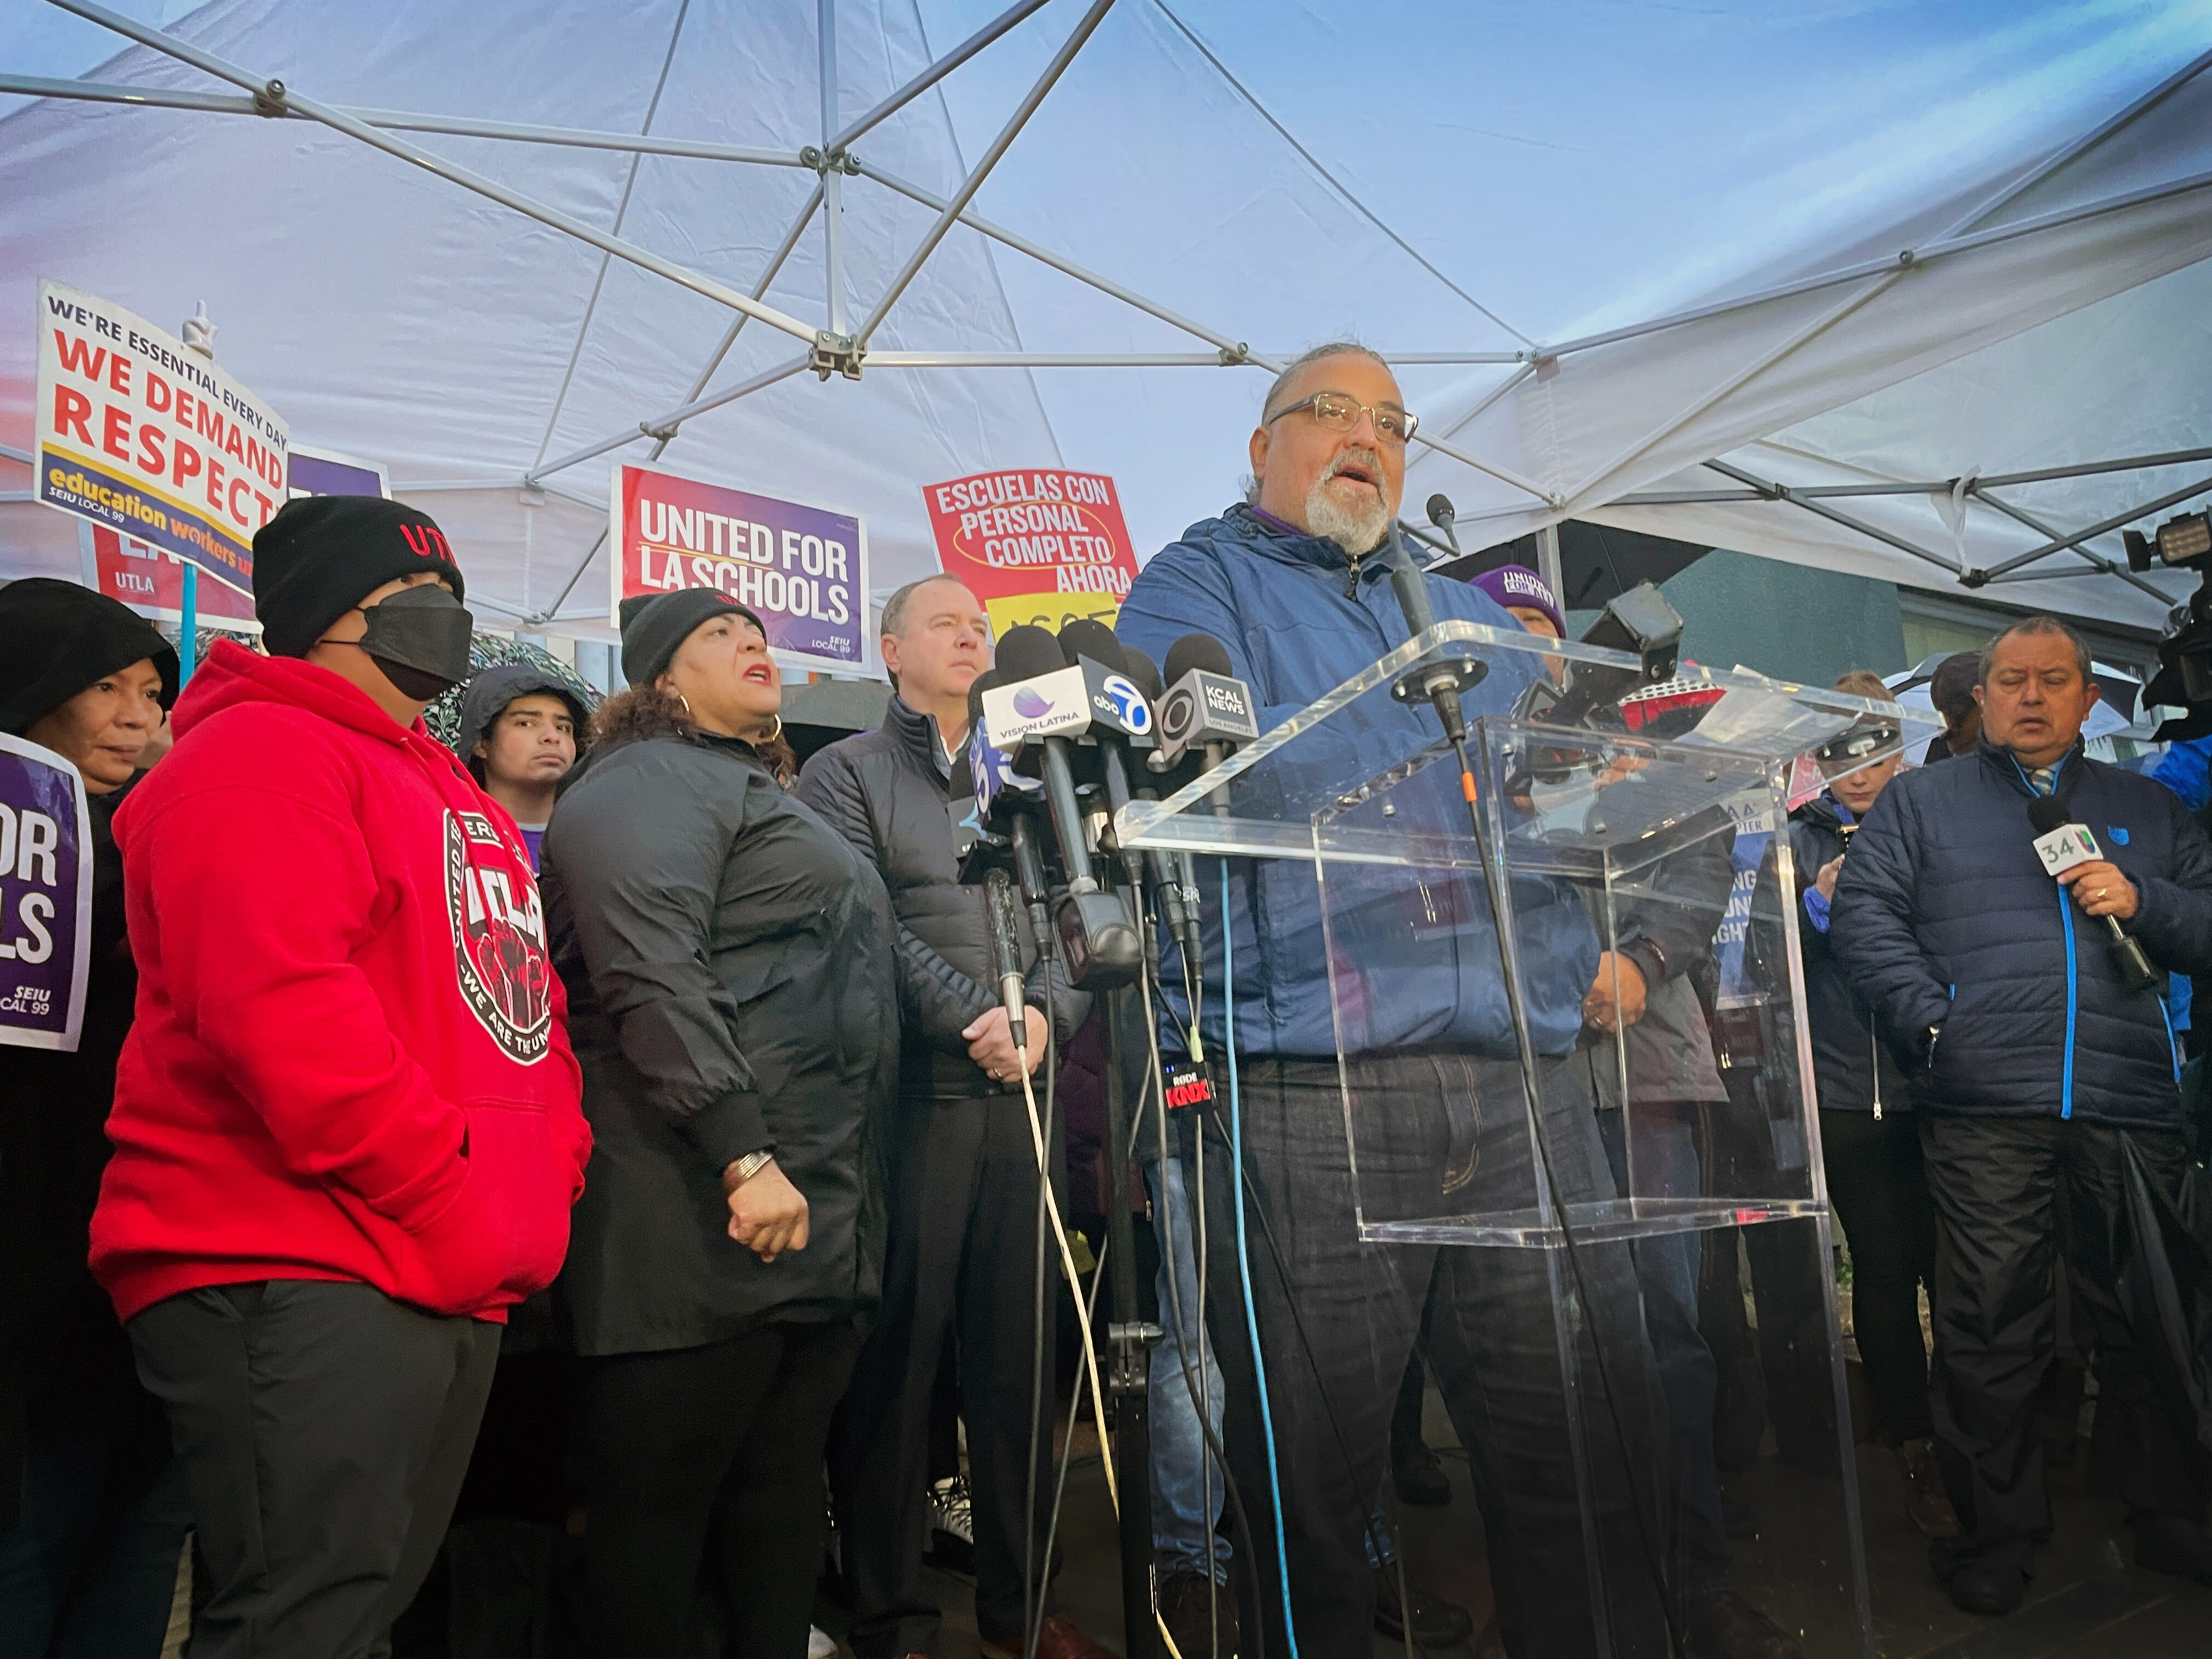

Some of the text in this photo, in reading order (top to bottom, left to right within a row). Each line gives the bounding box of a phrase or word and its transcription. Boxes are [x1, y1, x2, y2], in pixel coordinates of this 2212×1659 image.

[48, 296, 287, 452] WE'RE ESSENTIAL EVERY DAY
[54, 328, 282, 489] WE DEMAND
[49, 486, 125, 523] SEIU LOCAL 99
[936, 474, 1110, 514] ESCUELAS CON
[49, 468, 166, 530] education
[170, 518, 237, 568] workers
[961, 505, 1089, 540] PERSONAL
[641, 499, 848, 582] UNITED FOR
[985, 536, 1112, 567] COMPLETO
[115, 571, 154, 593] UTLA
[641, 545, 849, 625] LA SCHOOLS
[1057, 565, 1132, 595] AHORA
[811, 639, 838, 652] LOCAL
[830, 636, 850, 646] SEIU
[1094, 695, 1119, 715] abc
[1206, 685, 1242, 704] KCAL
[1208, 697, 1245, 715] NEWS
[1000, 712, 1079, 738] VISION LATINA
[2042, 838, 2074, 863] 34
[14, 986, 51, 1002] SEIU
[31, 1001, 49, 1015] 99
[489, 1012, 512, 1046] ARE
[1166, 1078, 1211, 1109] KNX
